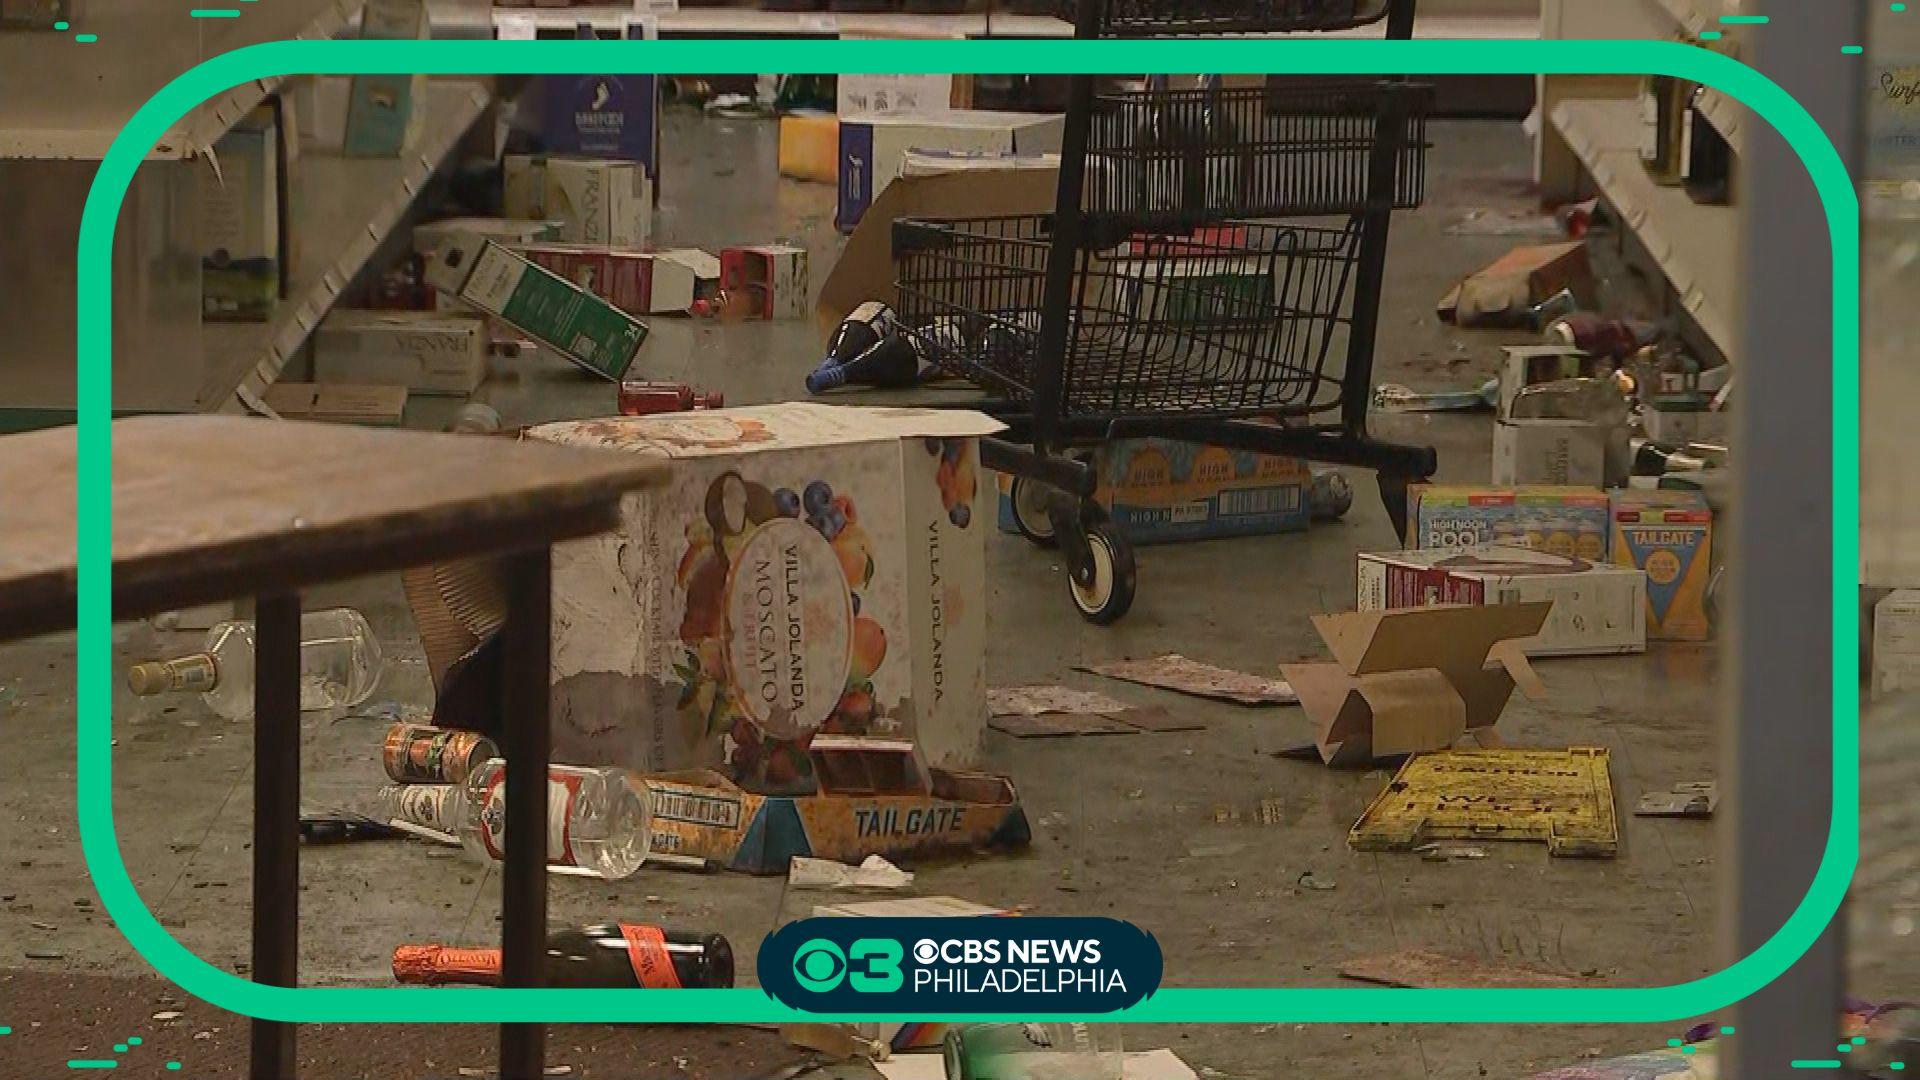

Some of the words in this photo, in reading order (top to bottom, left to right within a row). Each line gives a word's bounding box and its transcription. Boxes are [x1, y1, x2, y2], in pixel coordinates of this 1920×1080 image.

[584, 167, 601, 243] FRANZI
[1199, 462, 1229, 475] HIGH
[1130, 511, 1160, 523] HIGH
[1631, 531, 1695, 545] TAILGATE
[784, 544, 799, 606] VILLA
[928, 519, 942, 587] VILLA
[755, 560, 778, 704] MOSCATO
[787, 612, 805, 713] JOLANDA
[931, 593, 944, 701] JOLANDA
[855, 806, 967, 838] TAILGATE
